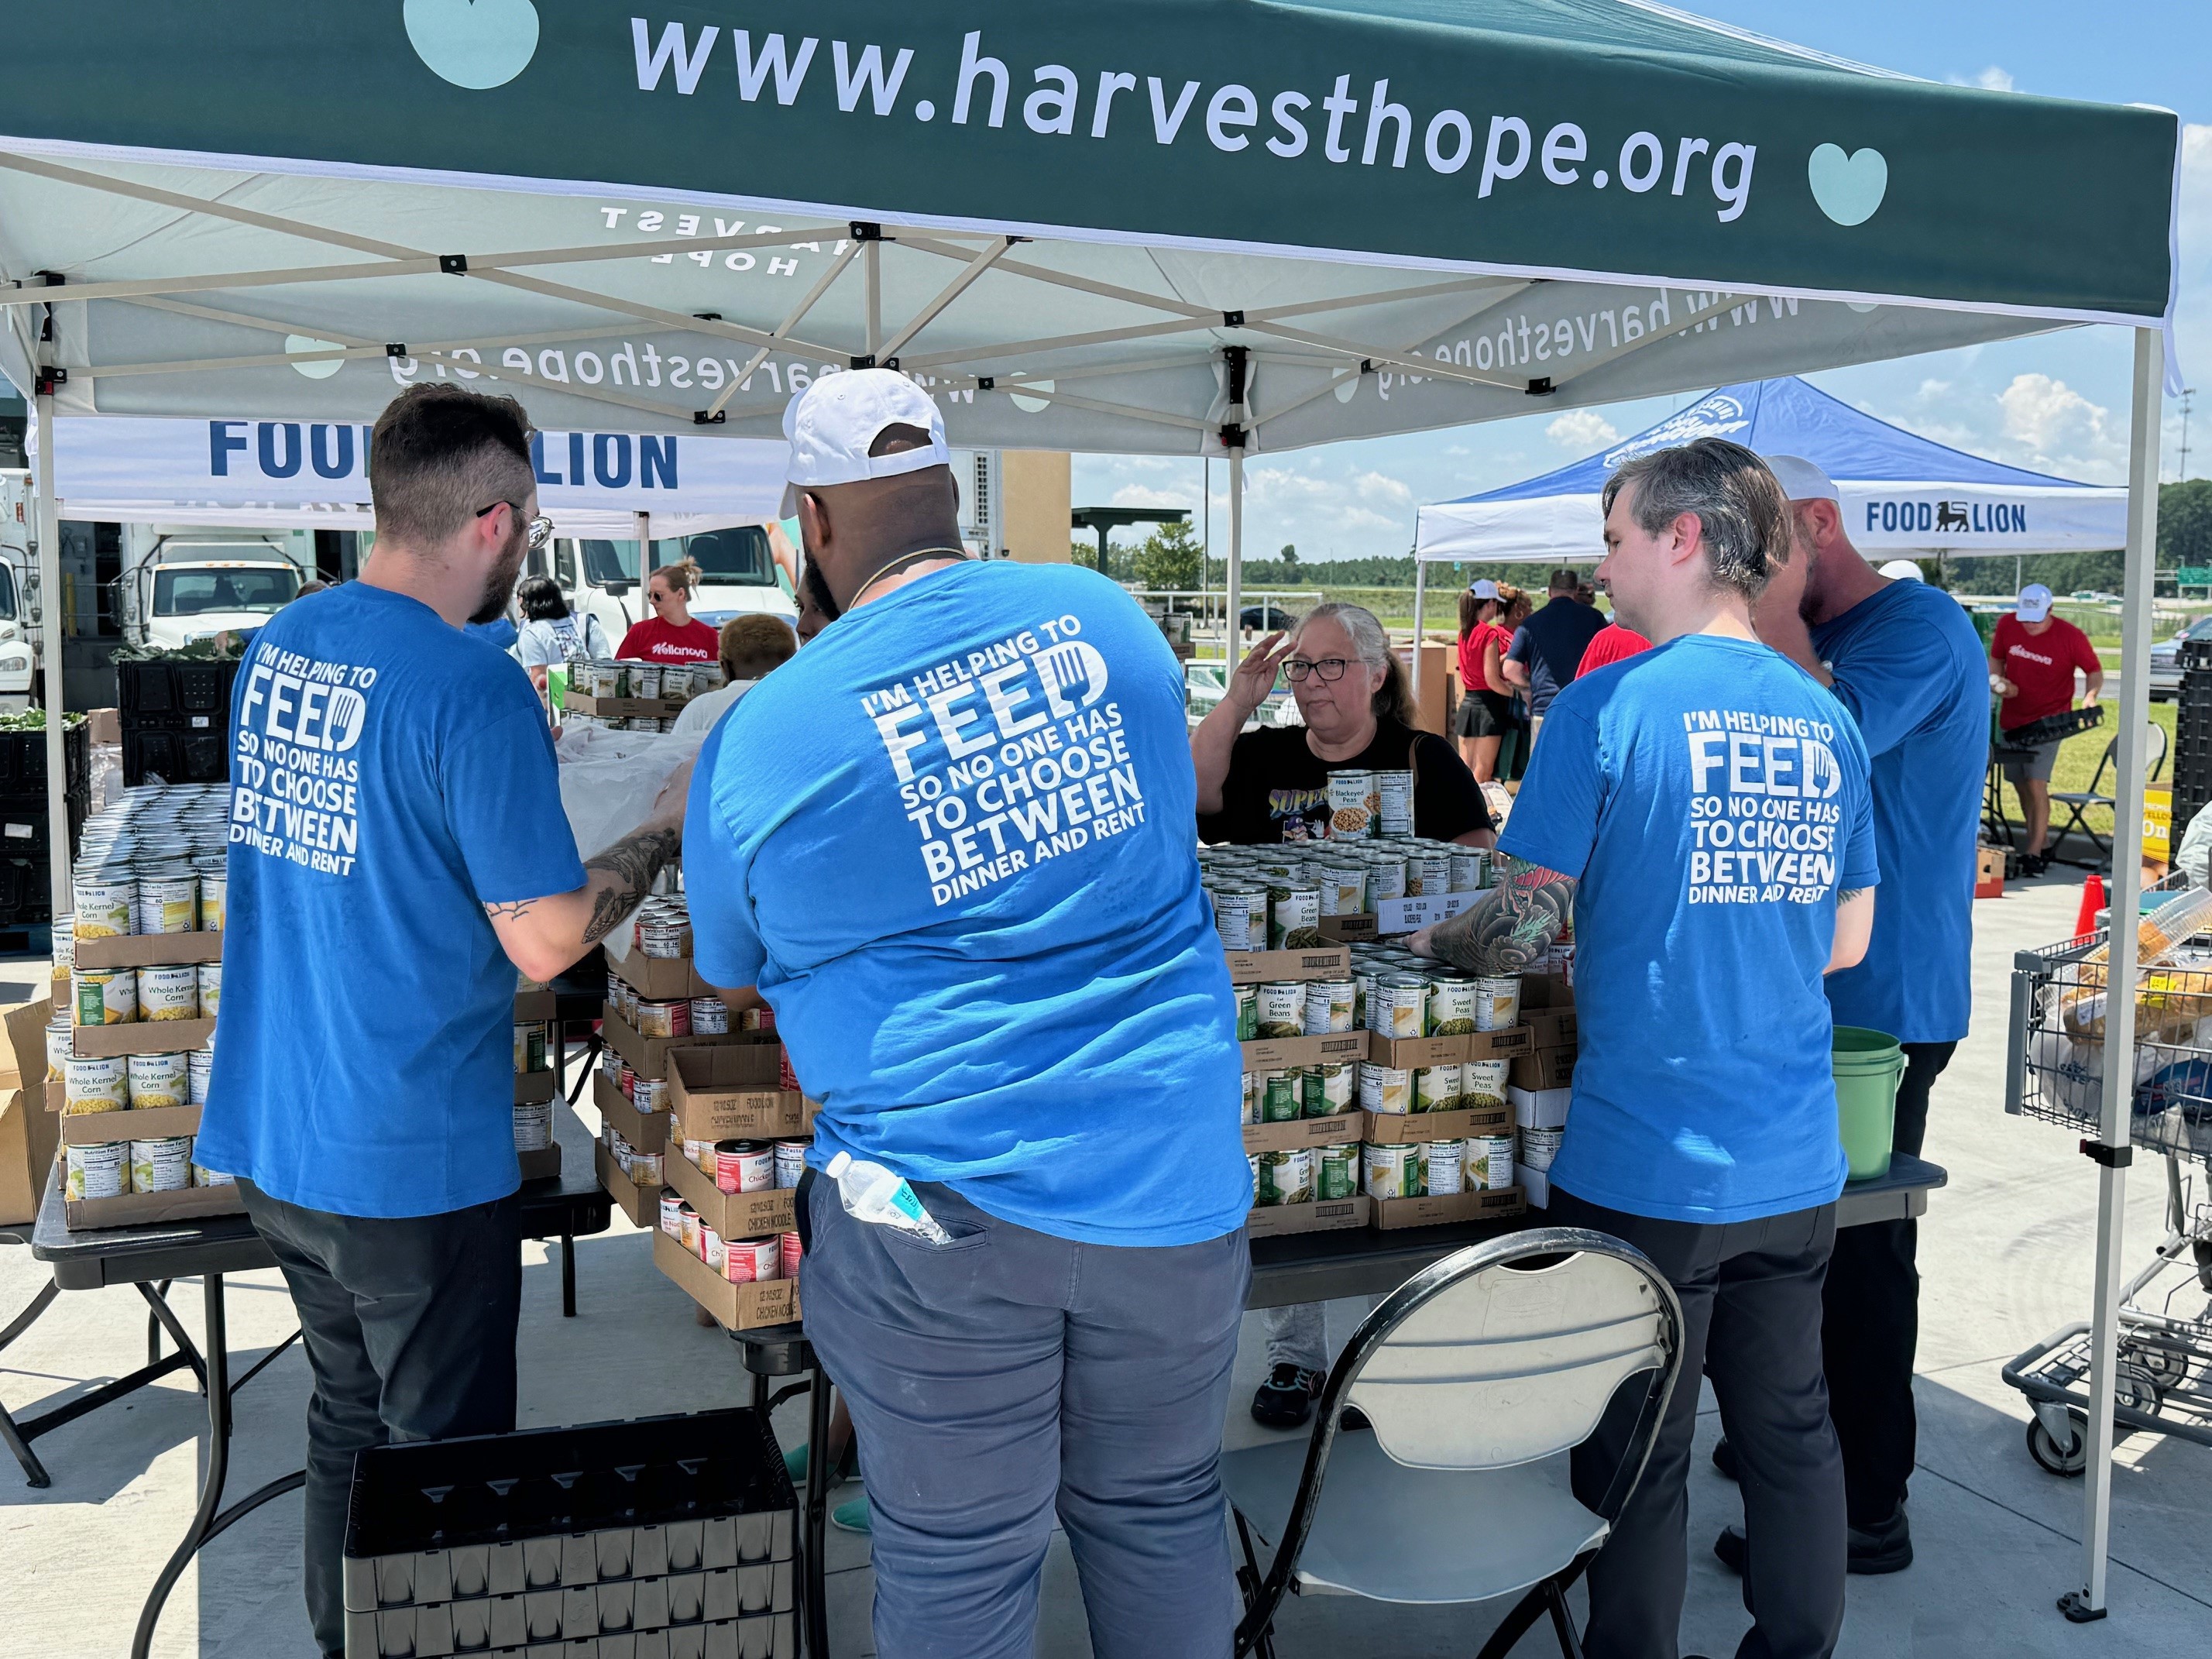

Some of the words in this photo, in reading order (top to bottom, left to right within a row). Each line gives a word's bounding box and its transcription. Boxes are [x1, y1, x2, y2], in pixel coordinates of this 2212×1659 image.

[630, 17, 1757, 223] www.harvesthope.org
[210, 421, 373, 479] FOO
[531, 431, 678, 490] LION
[1866, 501, 1932, 533] FOOD
[1973, 503, 2026, 533] LION
[256, 641, 281, 668] I'M
[276, 650, 349, 685] HELPING
[349, 666, 377, 689] TO
[652, 641, 708, 659] Kellanova
[860, 682, 913, 718] I'M
[913, 631, 1040, 697] HELPING
[1039, 614, 1081, 644] TO
[240, 663, 366, 752] FEED
[873, 641, 1108, 783] FEED
[1683, 709, 1722, 732] I'M
[1723, 709, 1809, 737] HELPING
[1810, 720, 1834, 744] TO
[238, 730, 259, 756] SO
[263, 738, 287, 766] NO
[288, 747, 321, 776] ONE
[322, 755, 359, 783] HAS
[900, 775, 943, 810] SO
[946, 755, 994, 791] NO
[999, 725, 1063, 767] ONE
[1066, 702, 1122, 743] HAS
[1688, 730, 1842, 799] FEED
[237, 754, 266, 790] TO
[271, 767, 357, 816] CHOOSE
[907, 795, 967, 840] TO
[975, 729, 1132, 812] CHOOSE
[920, 763, 1142, 884] BETWEEN
[1691, 795, 1723, 819] SO
[1728, 796, 1758, 818] NO
[1761, 798, 1802, 822] ONE
[1805, 801, 1840, 824] HAS
[1691, 819, 1735, 849] TO
[1738, 819, 1836, 853] CHOOSE
[285, 841, 309, 867] AND
[311, 850, 356, 877] RENT
[931, 850, 1029, 907] DINNER
[1034, 827, 1089, 864] AND
[1093, 802, 1146, 841] RENT
[88, 902, 115, 910] Kernel
[1688, 885, 1758, 905] DINNER
[69, 1077, 91, 1085] Whole
[92, 1074, 117, 1084] Kernel
[150, 1071, 176, 1080] Kernel
[1472, 1073, 1493, 1081] Sweet
[784, 1197, 795, 1208] FOO
[747, 1216, 771, 1231] CHICKEN
[771, 1212, 792, 1228] NOODLE
[756, 1304, 778, 1321] CHICKEN
